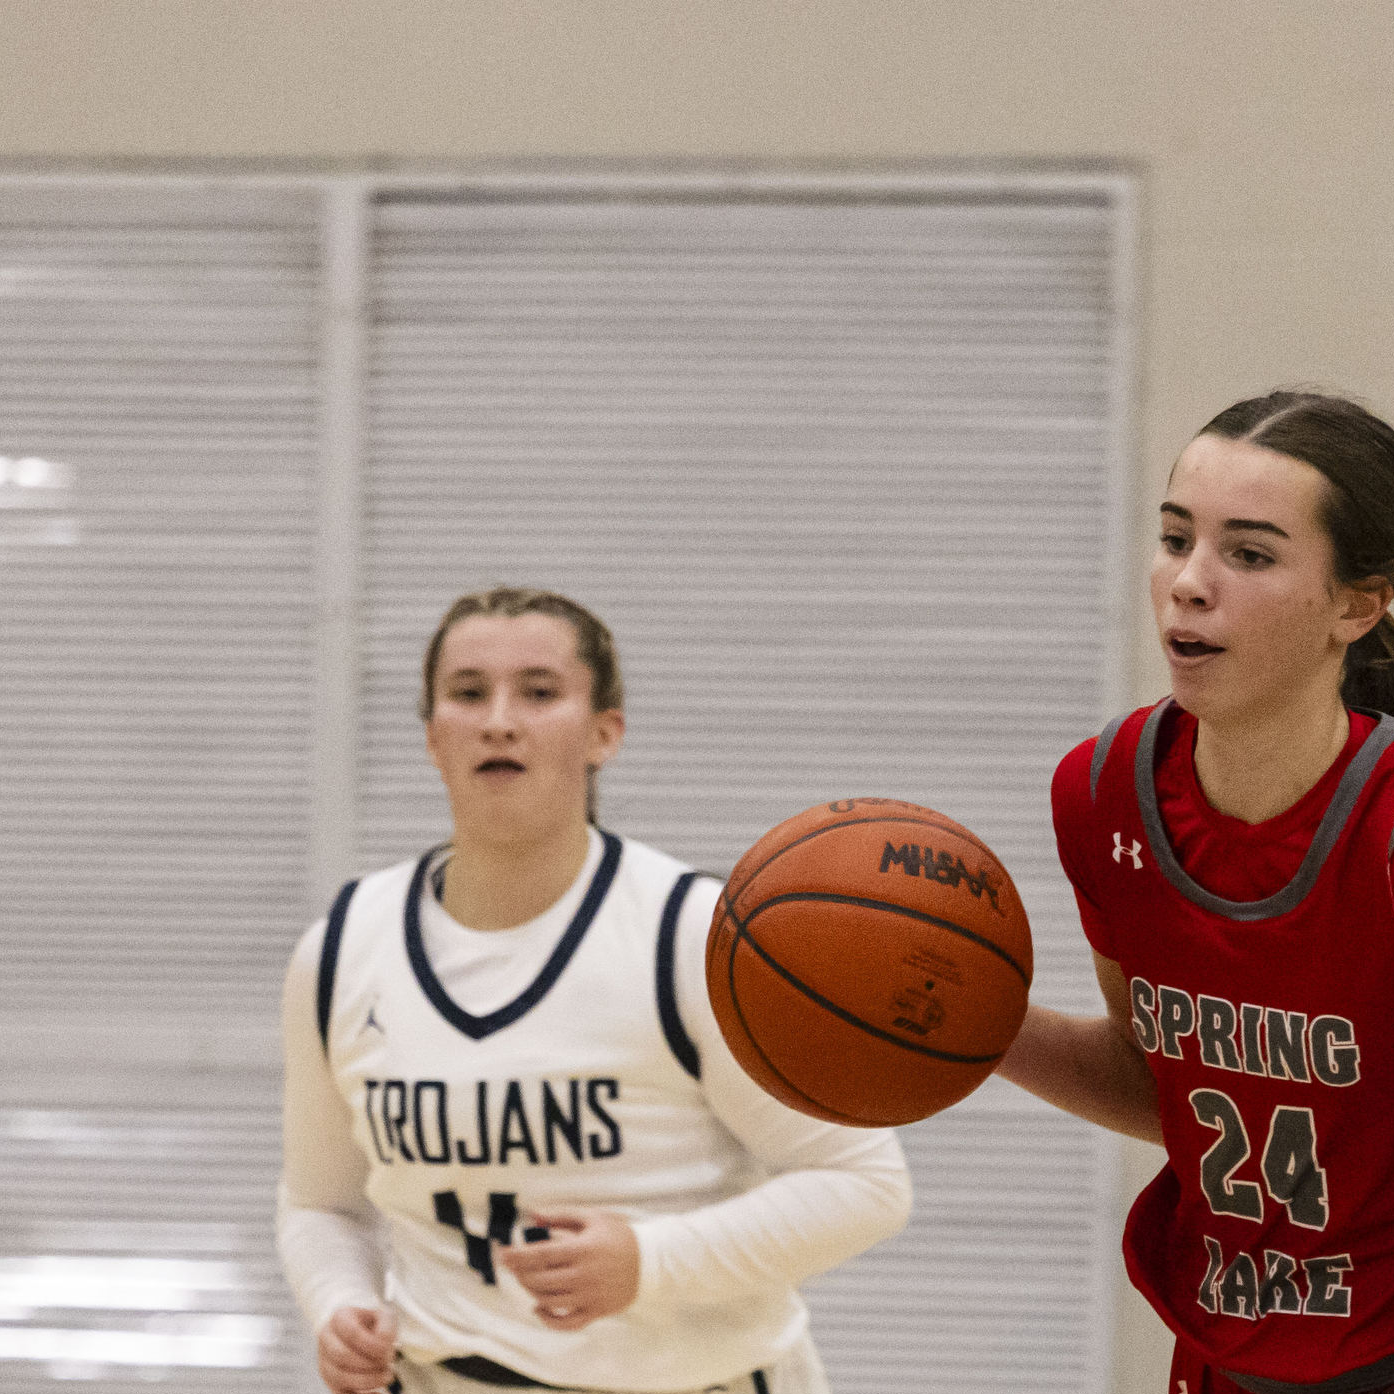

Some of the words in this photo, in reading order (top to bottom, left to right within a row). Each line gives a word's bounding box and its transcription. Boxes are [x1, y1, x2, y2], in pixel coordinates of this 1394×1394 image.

[1129, 975, 1362, 1087] SPRING
[364, 1077, 624, 1166] TROJANS
[1188, 1087, 1330, 1232] 24
[1196, 1233, 1355, 1321] LAKE
